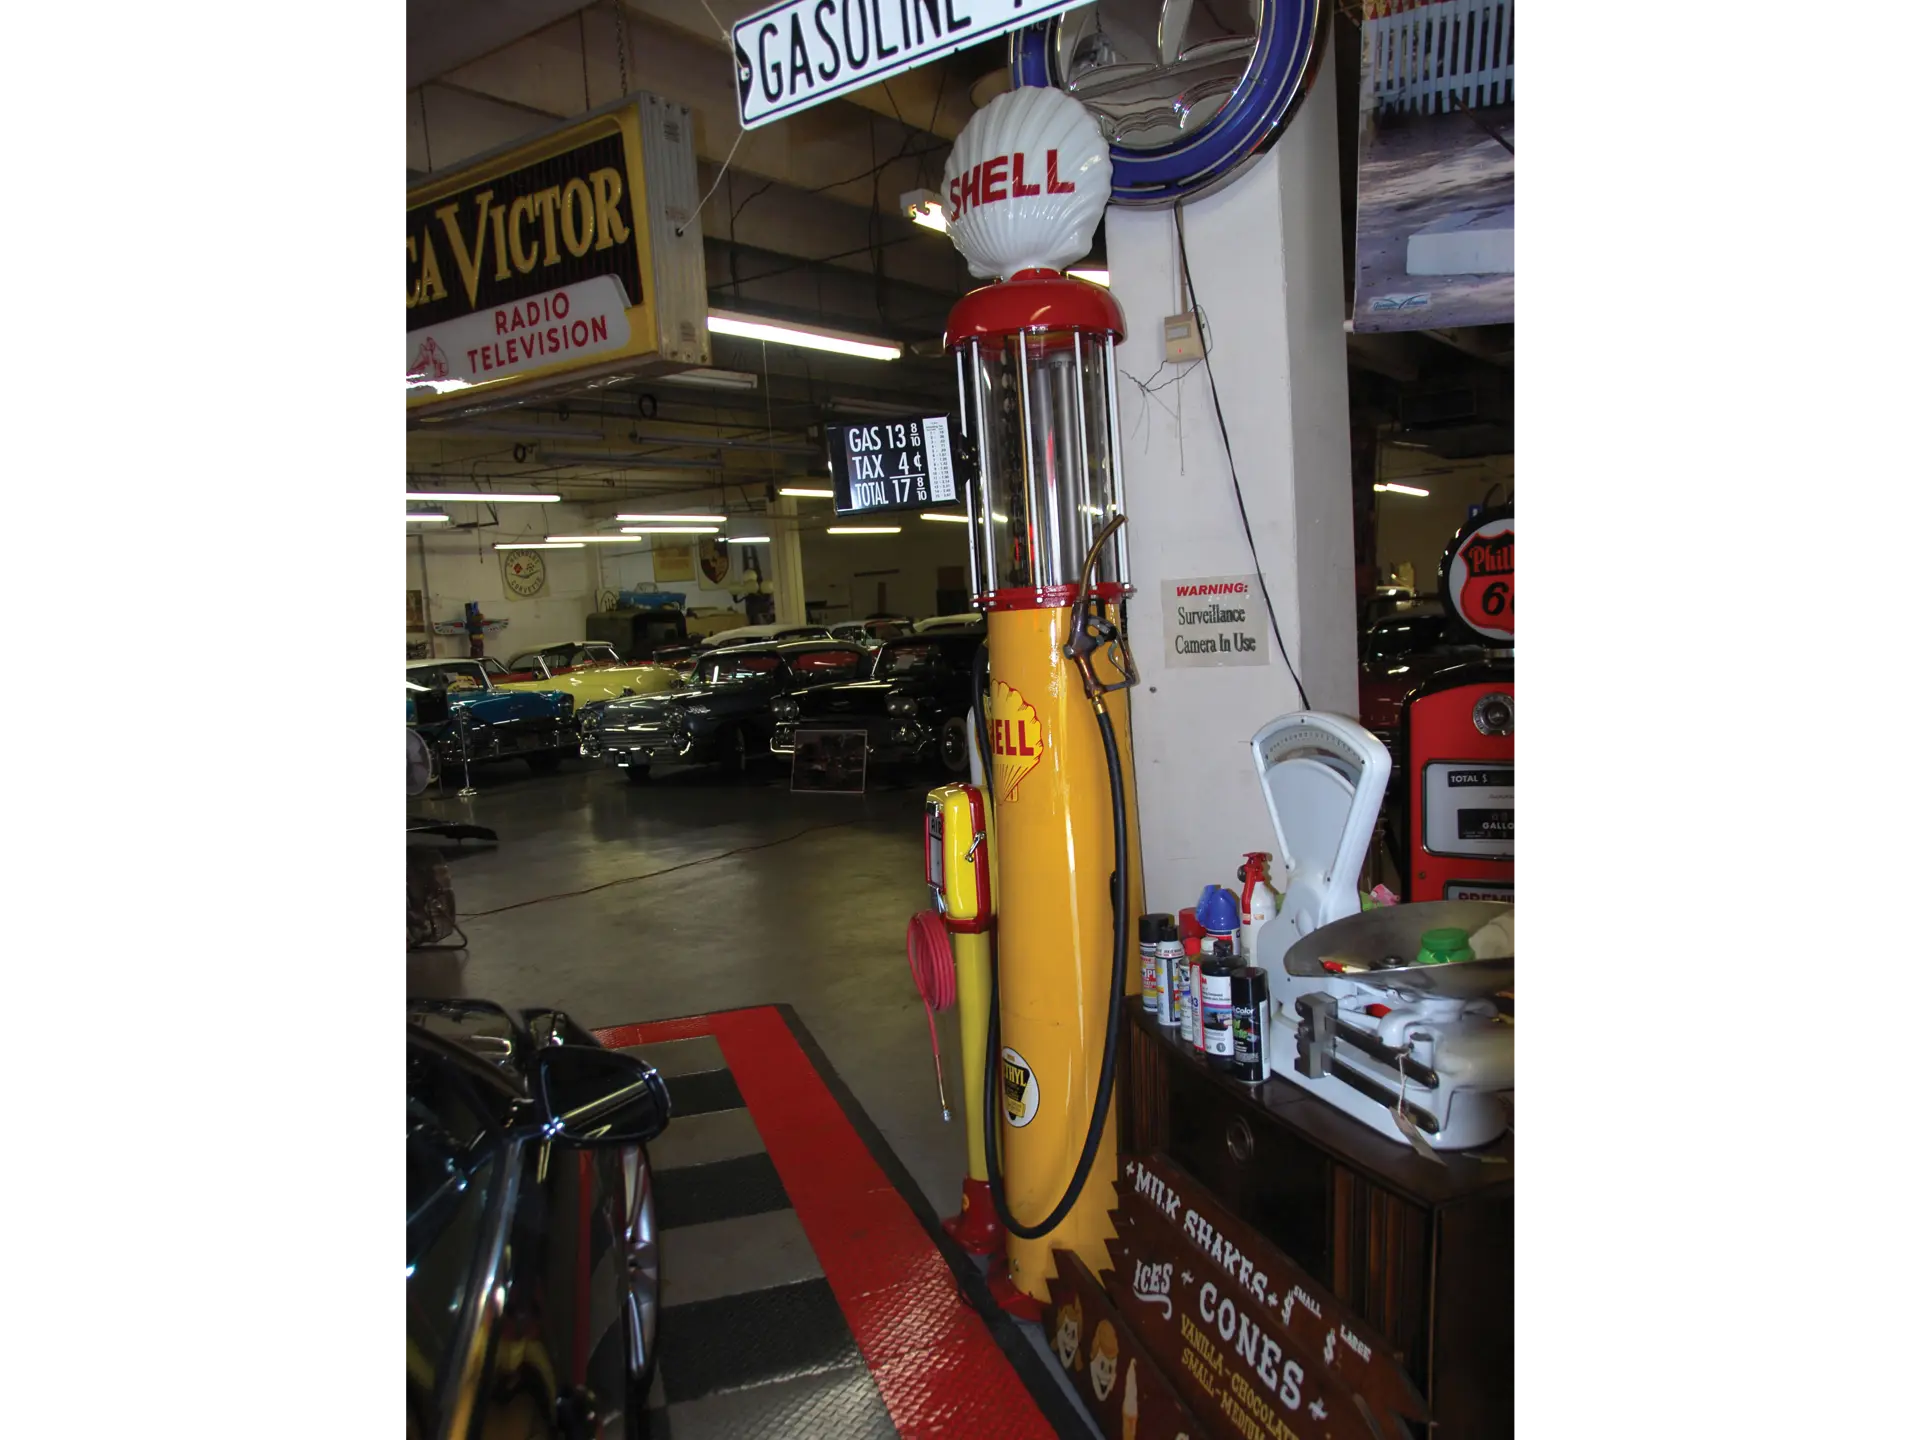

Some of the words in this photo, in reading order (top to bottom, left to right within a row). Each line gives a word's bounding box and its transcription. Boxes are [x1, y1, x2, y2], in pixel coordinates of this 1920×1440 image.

[949, 148, 1076, 222] SHELL
[435, 166, 630, 311] VICTOR
[494, 291, 570, 336] RADIO
[467, 314, 608, 374] TELEVISION
[849, 426, 881, 452] GAS
[886, 424, 906, 448] 13
[911, 423, 918, 433] 8
[911, 436, 921, 446] 10
[852, 454, 884, 479] TAX
[855, 481, 889, 506] TOTAL
[893, 479, 910, 502] 17
[917, 477, 924, 487] 8
[917, 490, 927, 500] 10
[1176, 582, 1249, 597] WARNING:
[1177, 604, 1246, 626] Surveillance
[1174, 634, 1217, 655] Camera
[1218, 633, 1231, 652] In
[1233, 632, 1256, 652] Use
[1450, 774, 1479, 784] TOTAL
[1482, 773, 1488, 784] $
[1482, 821, 1516, 831] GALLO
[1135, 1163, 1181, 1219] MILK
[1183, 1209, 1268, 1304] SHAKES
[1293, 1284, 1322, 1319] SMALL
[1132, 1259, 1173, 1295] ICES
[1199, 1281, 1304, 1411] CONES
[1180, 1313, 1224, 1376] VANILLA
[1181, 1347, 1214, 1397] SMALL
